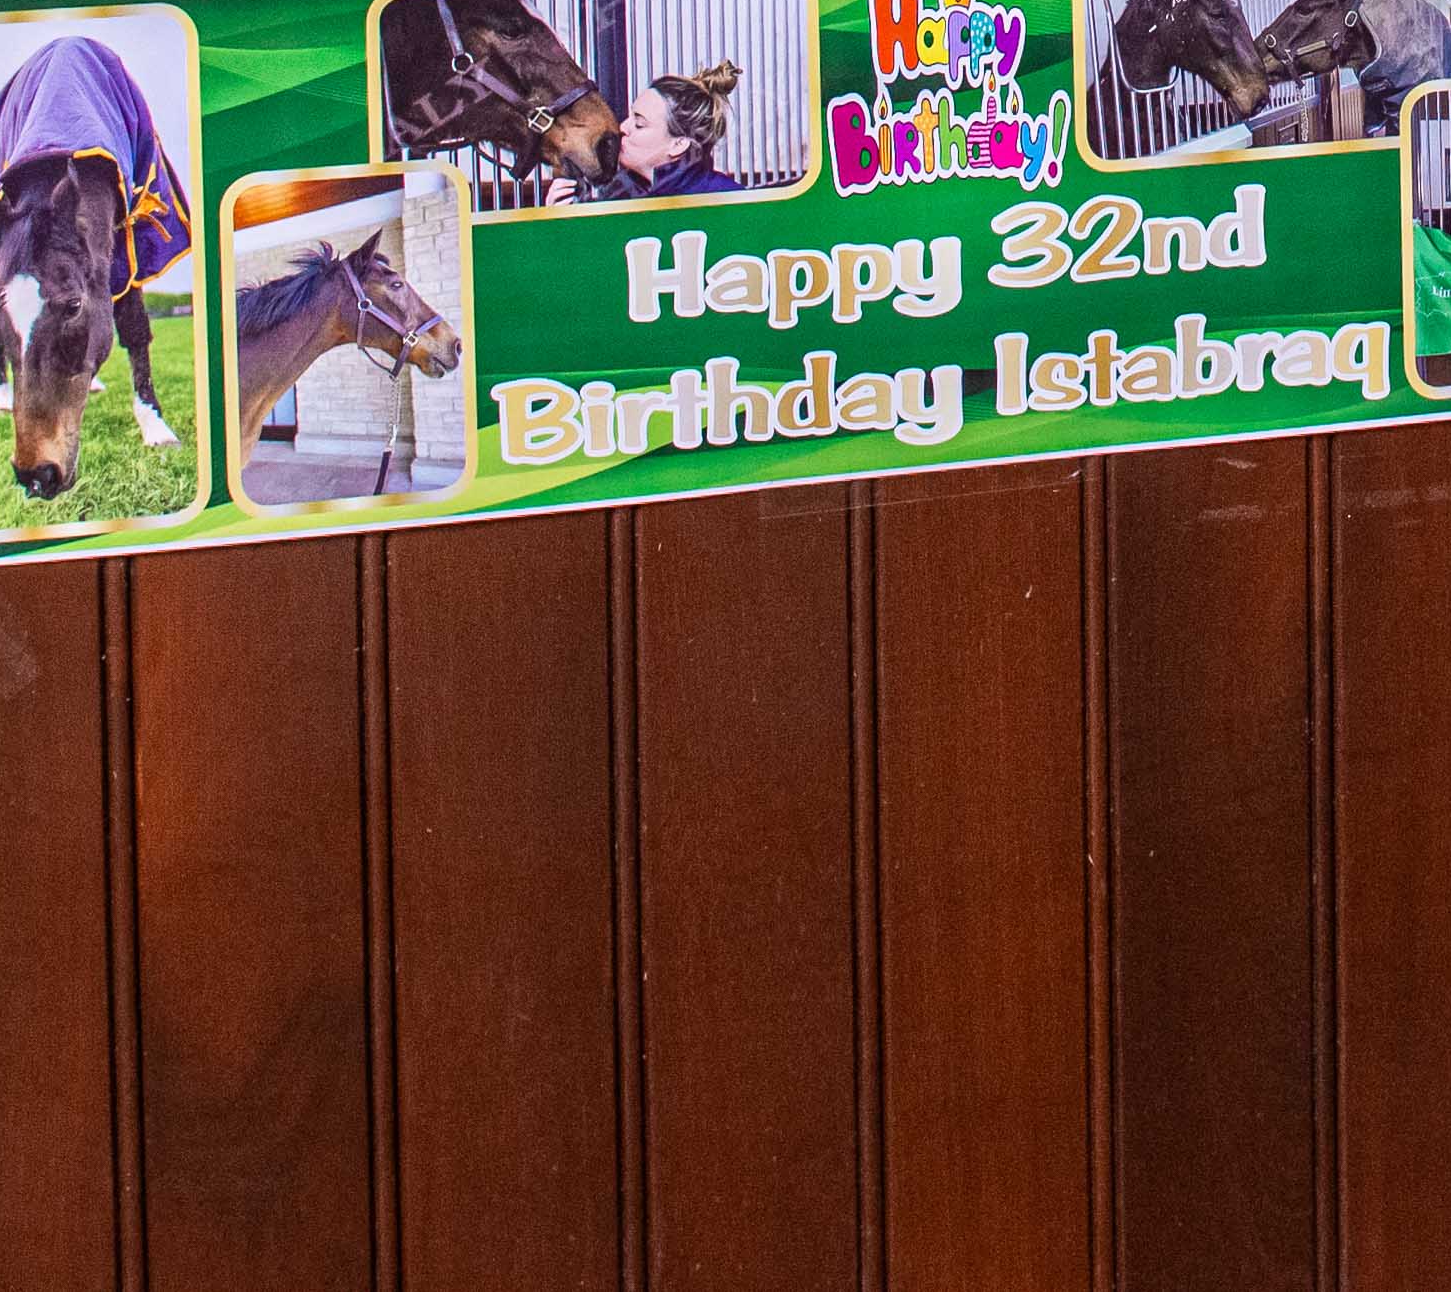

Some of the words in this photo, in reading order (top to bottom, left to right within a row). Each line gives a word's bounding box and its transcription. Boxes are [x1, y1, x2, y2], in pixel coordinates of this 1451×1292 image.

[830, 93, 1068, 190] Birthday!
[625, 230, 963, 329] Happy
[988, 184, 1266, 288] 32nd
[489, 350, 963, 466] Birthday
[993, 313, 1391, 417] Istabraq
